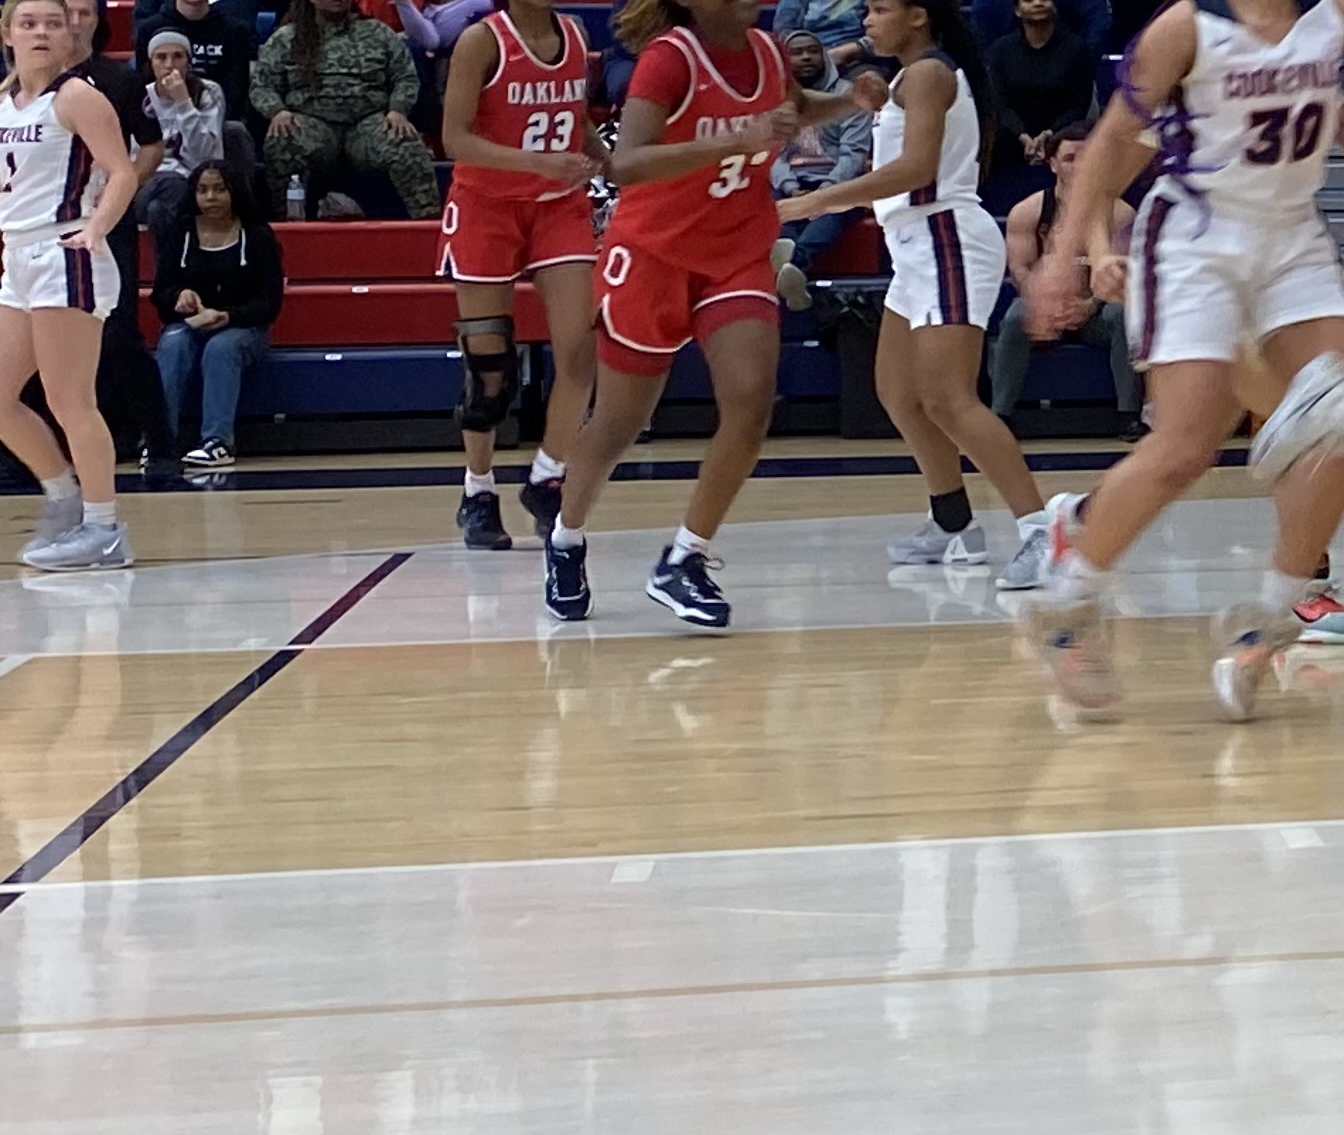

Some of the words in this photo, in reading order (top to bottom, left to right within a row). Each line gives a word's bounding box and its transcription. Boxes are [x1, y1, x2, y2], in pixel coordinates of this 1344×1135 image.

[507, 79, 586, 105] OAKLAN
[521, 110, 575, 152] 23
[1245, 102, 1324, 165] 30
